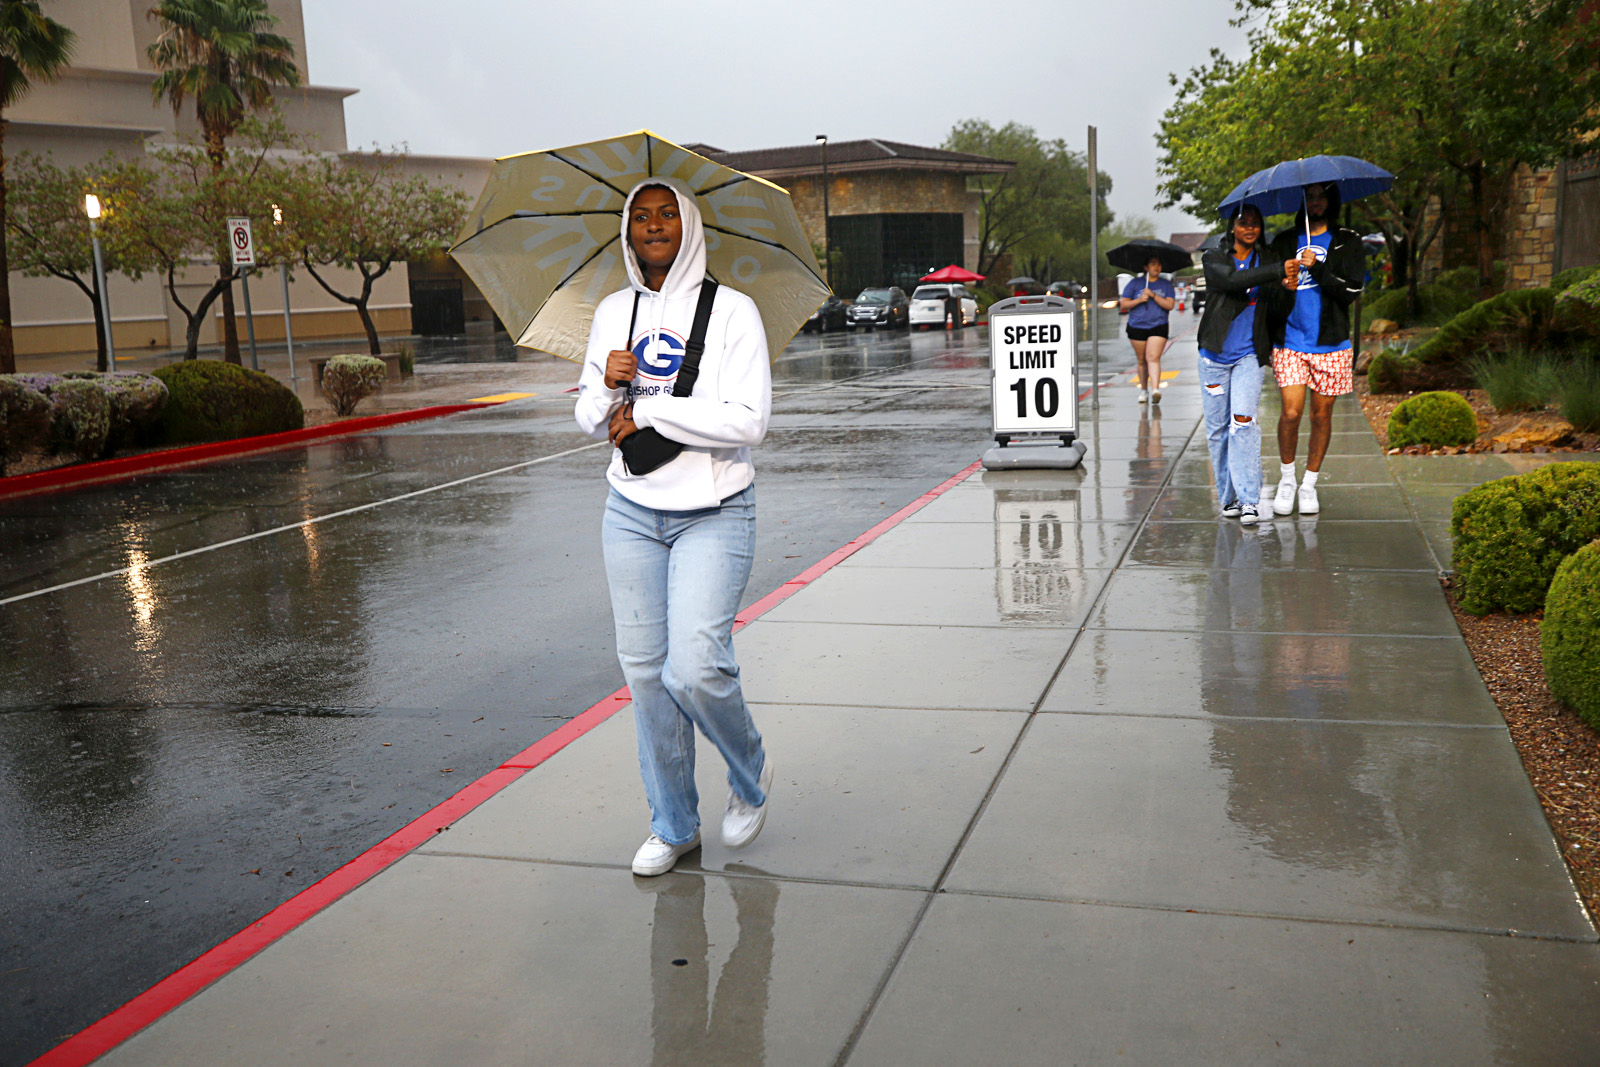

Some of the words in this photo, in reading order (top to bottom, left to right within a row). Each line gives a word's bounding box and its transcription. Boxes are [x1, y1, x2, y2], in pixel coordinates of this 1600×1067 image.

[1004, 325, 1061, 344] SPEED
[632, 333, 686, 377] G
[1010, 350, 1057, 369] LIMIT
[628, 386, 660, 396] BISHOP
[1010, 377, 1059, 418] 10
